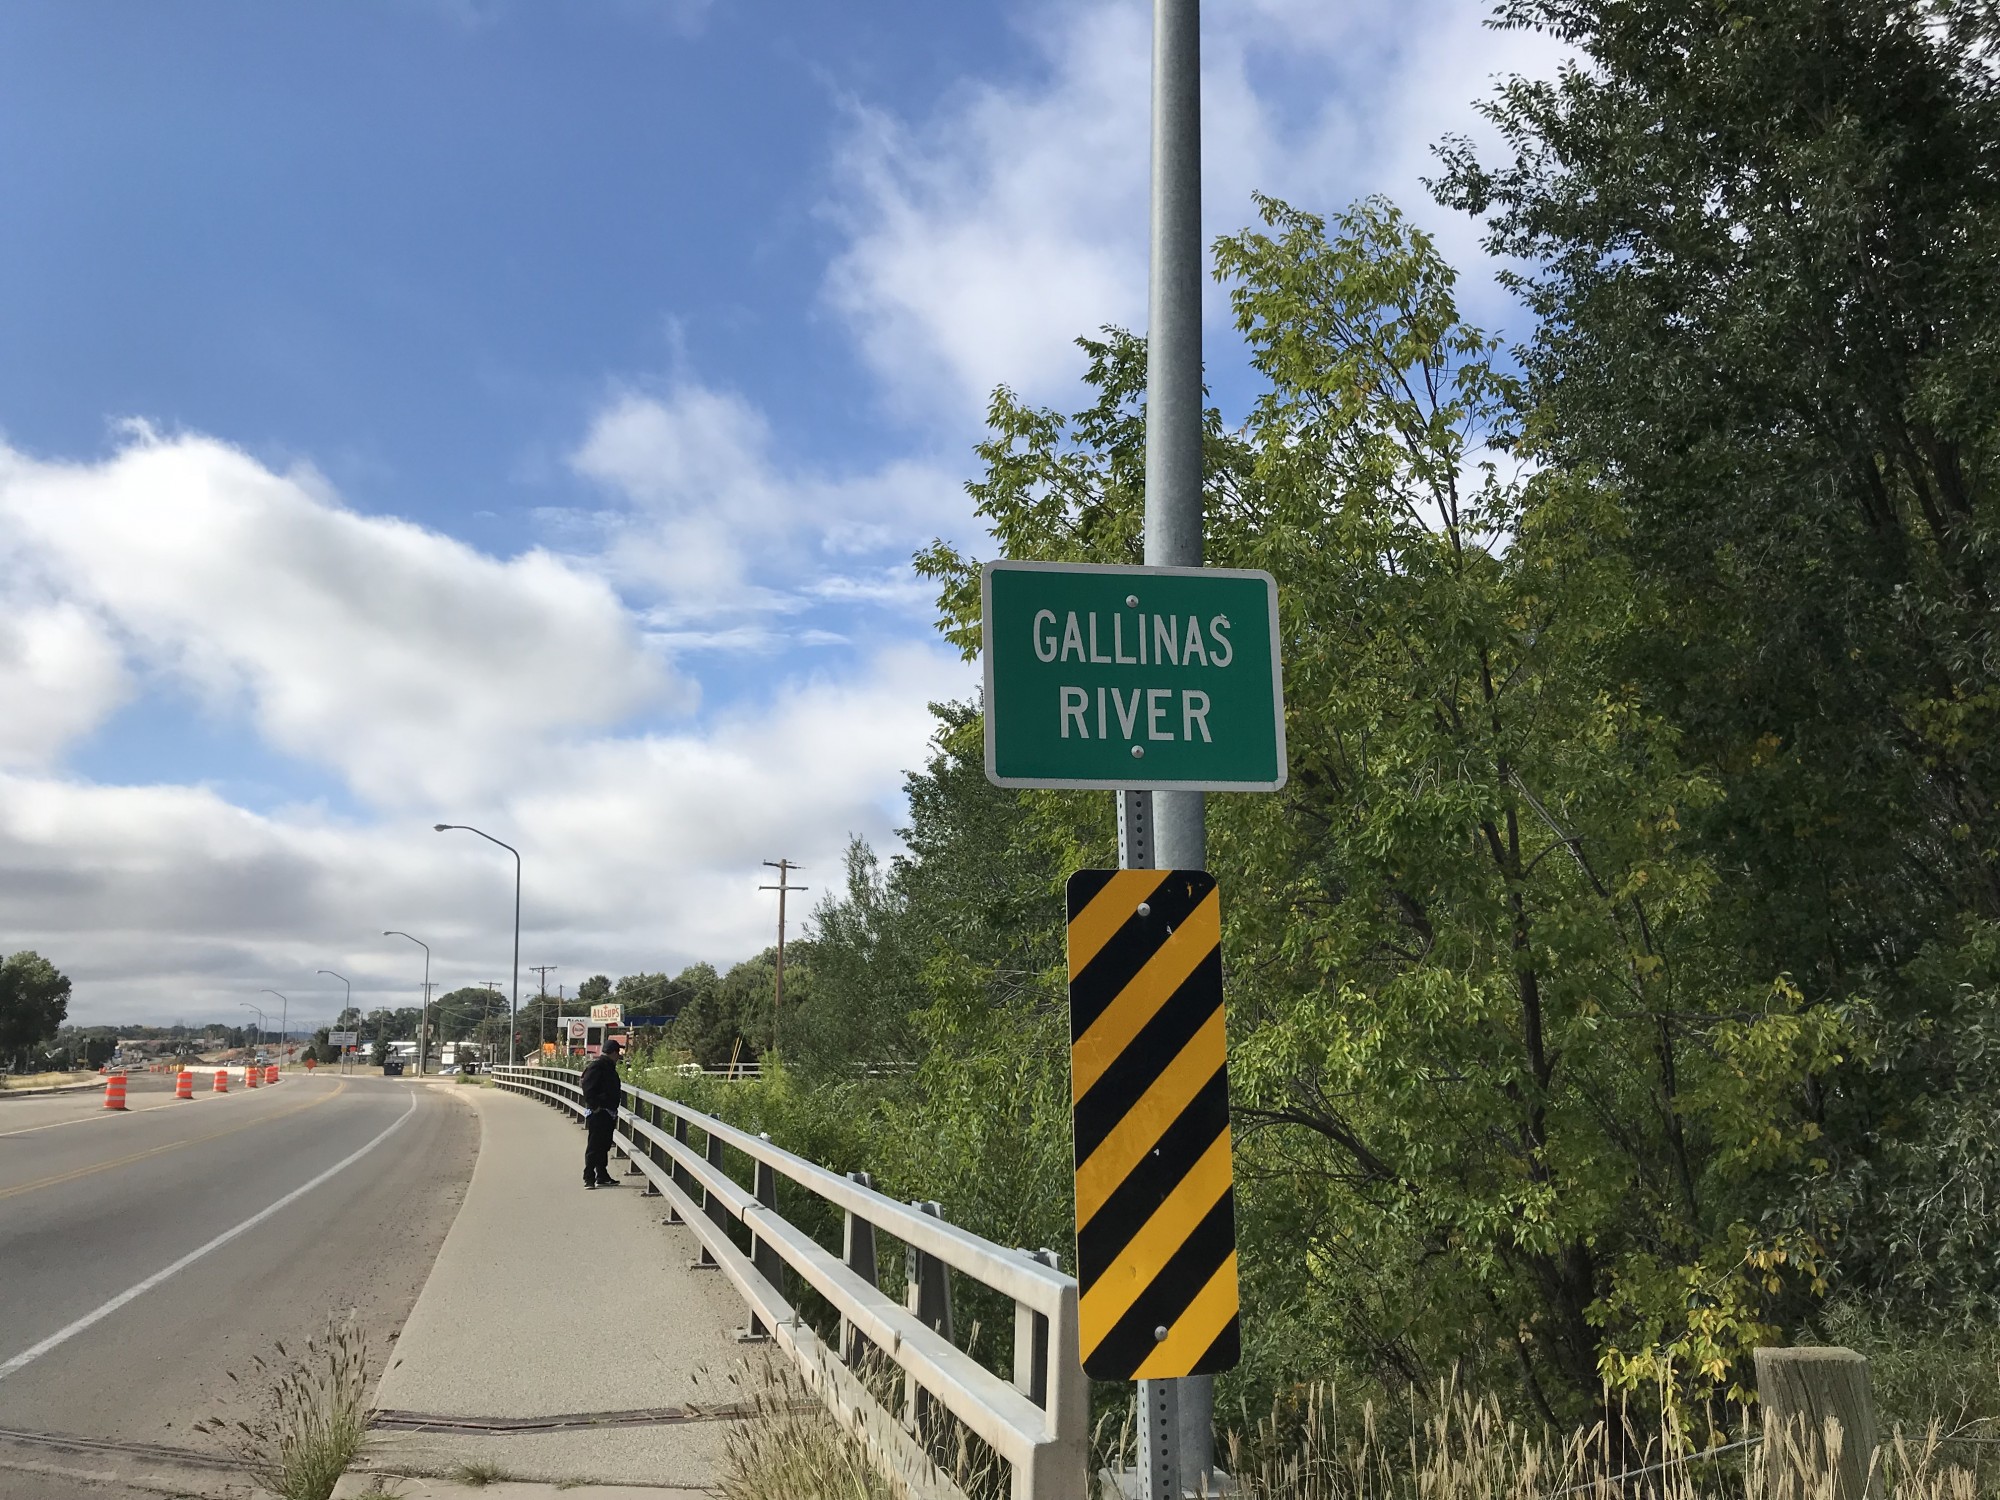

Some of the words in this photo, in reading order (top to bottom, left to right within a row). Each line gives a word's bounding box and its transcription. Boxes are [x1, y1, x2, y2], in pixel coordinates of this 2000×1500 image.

[1033, 608, 1233, 668] GALLINAS
[1059, 686, 1213, 743] RIVER
[592, 1006, 619, 1018] ALLSUP'S
